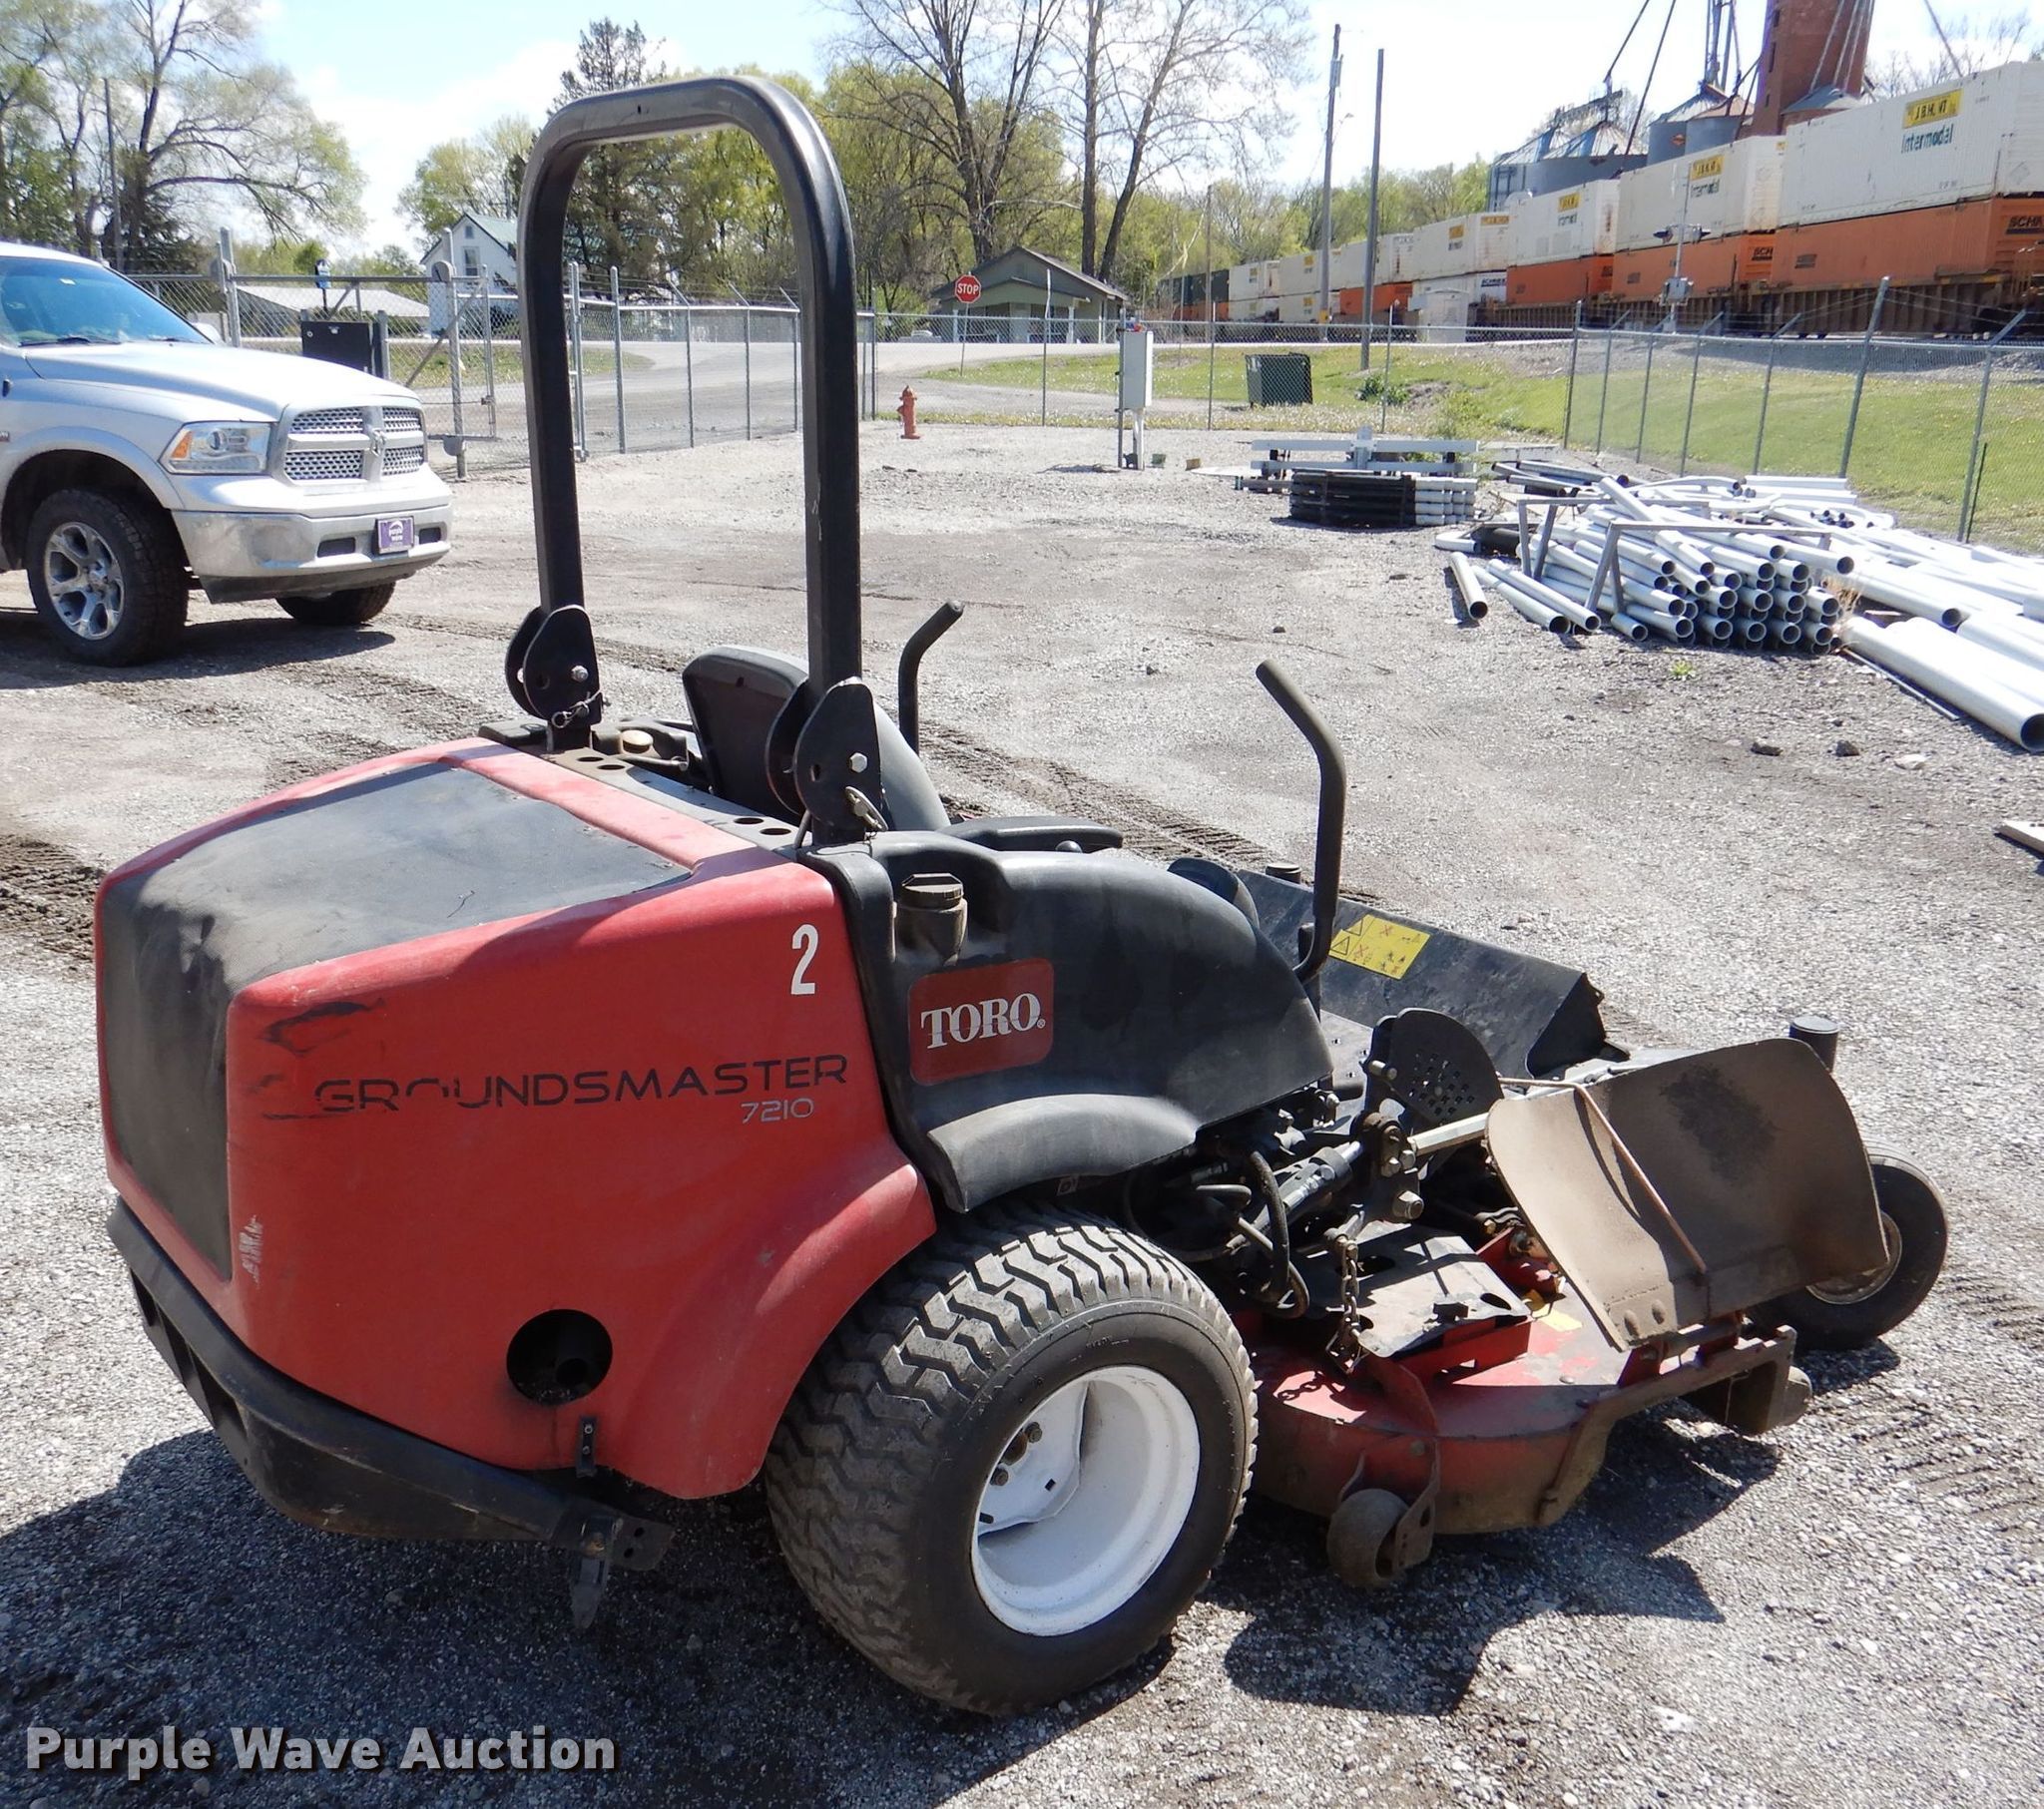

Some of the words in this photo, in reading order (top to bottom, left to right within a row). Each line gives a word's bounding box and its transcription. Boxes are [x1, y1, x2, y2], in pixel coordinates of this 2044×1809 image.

[957, 282, 979, 295] STOP
[790, 923, 819, 996] 2
[920, 992, 1041, 1050] TORO
[740, 1098, 815, 1125] 7210
